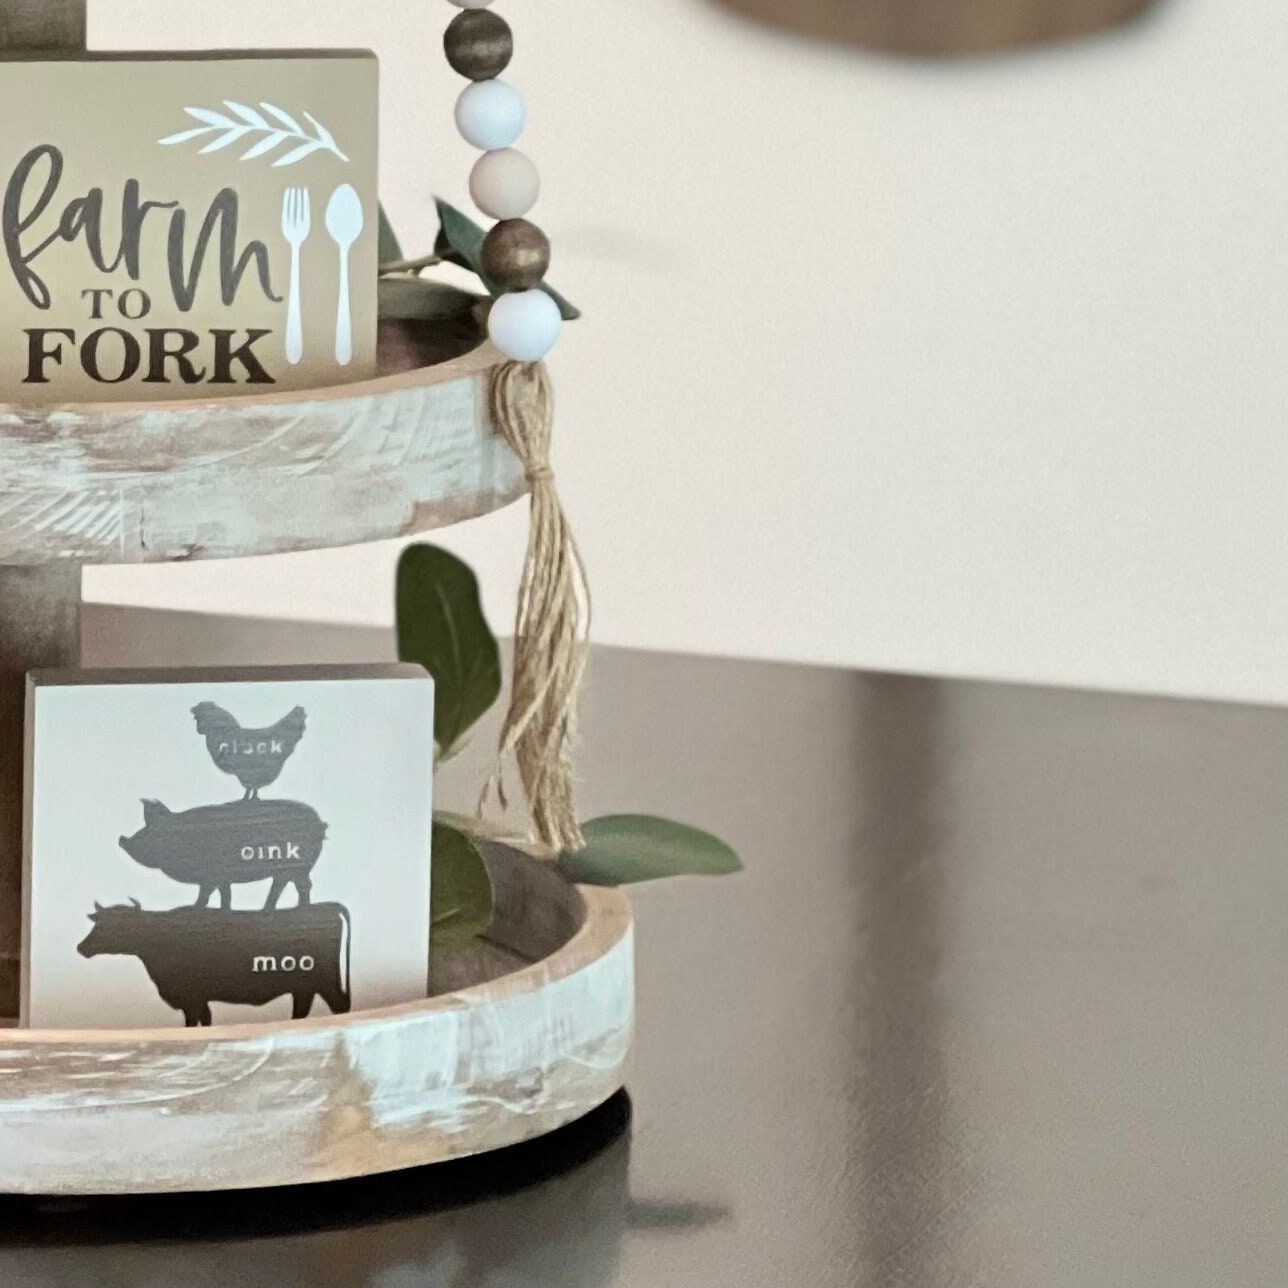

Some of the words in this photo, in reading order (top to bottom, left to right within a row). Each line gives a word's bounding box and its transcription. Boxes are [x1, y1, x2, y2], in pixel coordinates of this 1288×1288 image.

[2, 144, 284, 313] farm
[81, 287, 152, 320] TO
[22, 326, 277, 385] FORK
[240, 841, 301, 861] oink
[251, 954, 315, 973] moo
